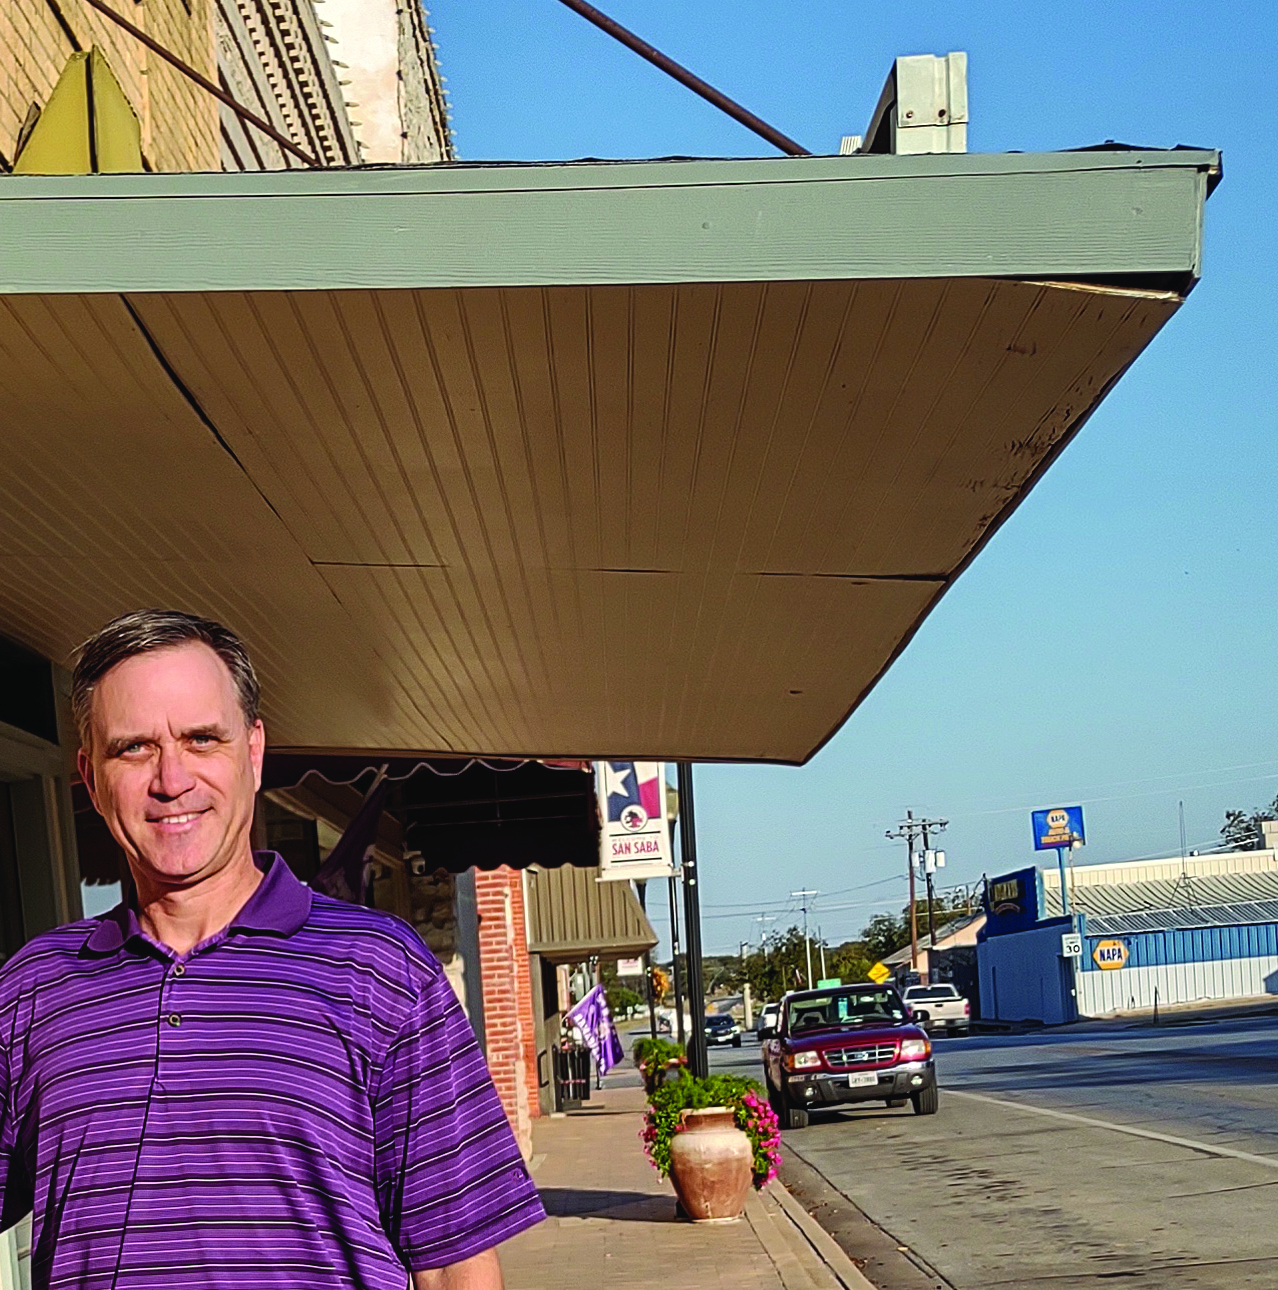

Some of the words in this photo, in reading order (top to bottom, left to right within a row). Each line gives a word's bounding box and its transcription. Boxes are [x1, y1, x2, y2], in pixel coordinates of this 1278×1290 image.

[612, 841, 632, 856] SAN
[633, 839, 660, 854] SABA
[1066, 944, 1080, 954] 30
[1099, 947, 1123, 961] NAPA
